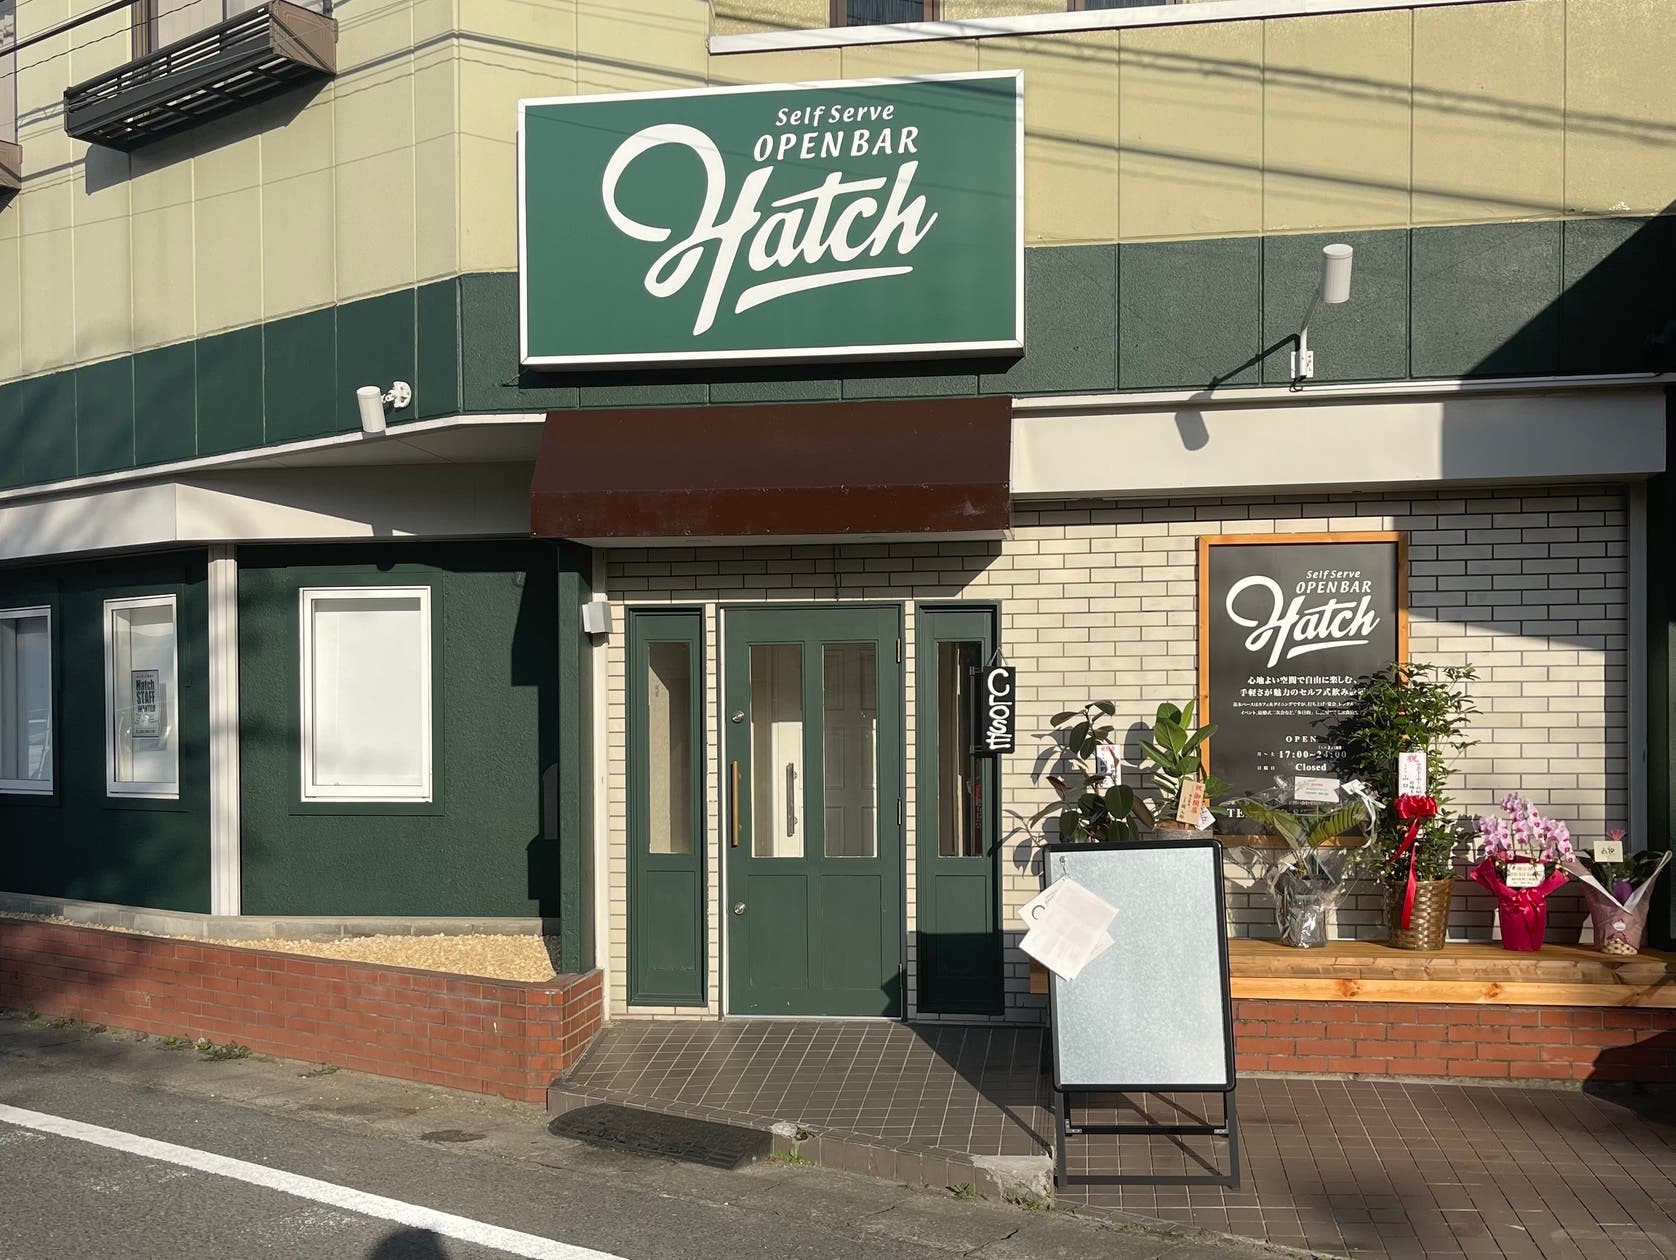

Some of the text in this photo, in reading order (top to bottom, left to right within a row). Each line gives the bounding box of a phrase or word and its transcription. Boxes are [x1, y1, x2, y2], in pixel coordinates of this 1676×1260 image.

[775, 104, 895, 127] Self Serve
[753, 126, 919, 162] OPEN BAR
[602, 123, 938, 336] Hatch
[1305, 569, 1361, 580] Self Serve
[1295, 580, 1372, 594] OPEN BAR
[1226, 575, 1381, 668] Hatch
[136, 690, 155, 705] STAFF
[1285, 735, 1317, 743] OPEN
[1295, 763, 1327, 772] Closed
